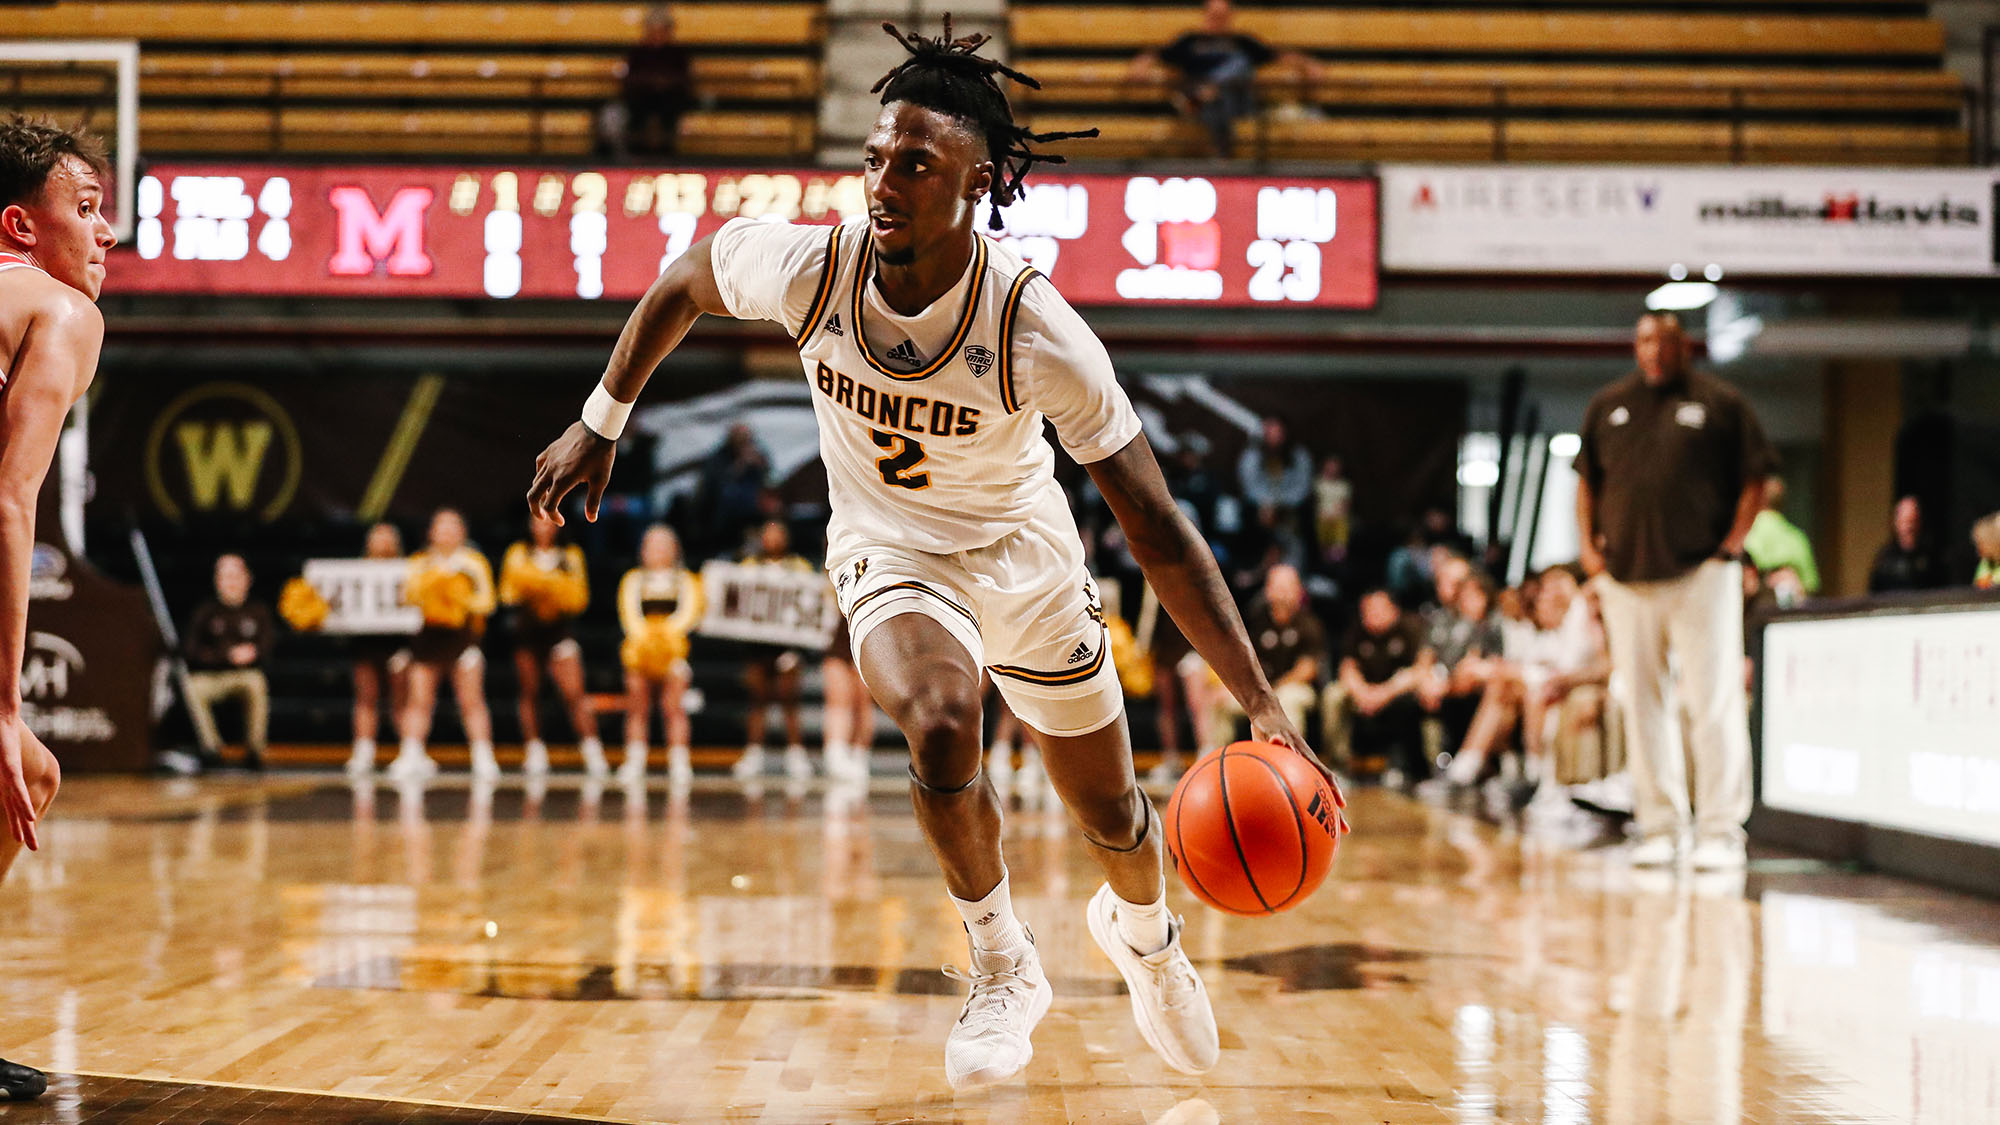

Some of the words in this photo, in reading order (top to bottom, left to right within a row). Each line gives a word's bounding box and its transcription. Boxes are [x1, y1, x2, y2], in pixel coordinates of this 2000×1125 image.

[328, 186, 434, 276] M
[1247, 240, 1321, 301] 23
[886, 350, 922, 368] adidas
[816, 359, 981, 437] BRONCOS
[176, 420, 273, 512] W
[868, 426, 932, 492] 2
[1067, 650, 1094, 665] adidas
